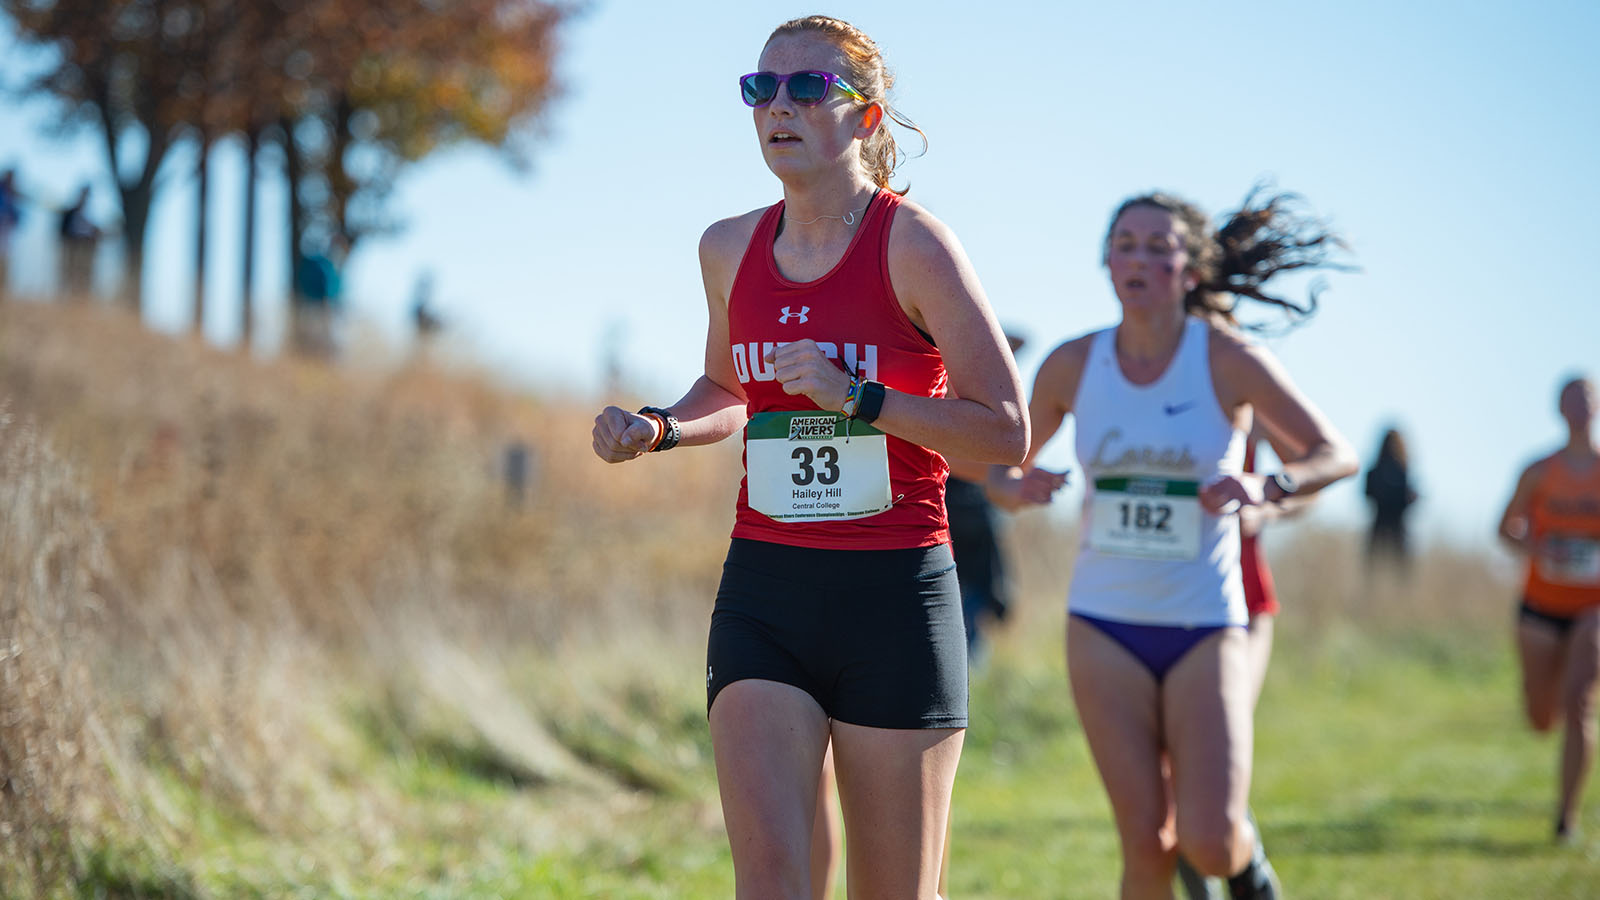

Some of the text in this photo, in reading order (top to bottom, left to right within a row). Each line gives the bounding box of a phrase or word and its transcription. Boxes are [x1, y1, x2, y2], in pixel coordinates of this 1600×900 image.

[731, 341, 878, 384] DUH
[792, 417, 836, 425] AMERICAN
[791, 446, 840, 486] 33
[792, 487, 842, 500] Hailey Hill
[816, 502, 841, 510] College
[1119, 501, 1173, 532] 182
